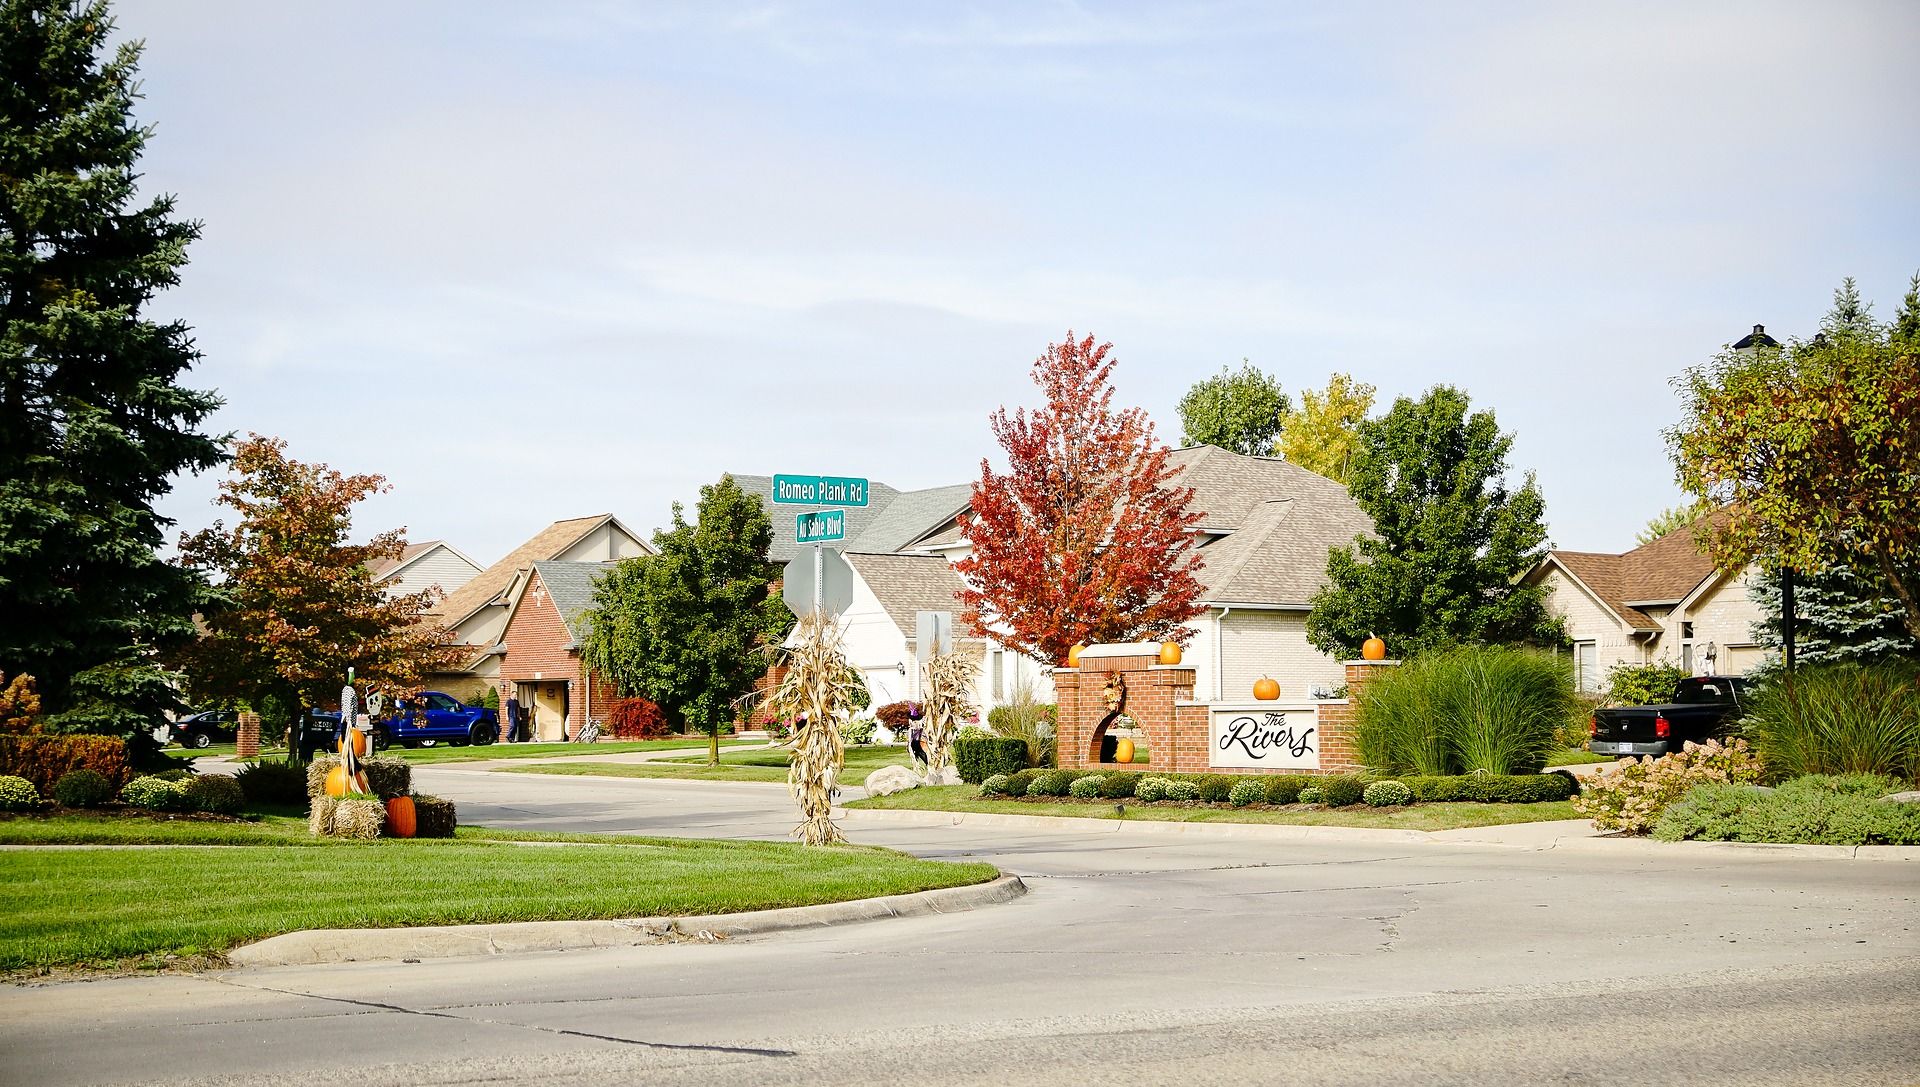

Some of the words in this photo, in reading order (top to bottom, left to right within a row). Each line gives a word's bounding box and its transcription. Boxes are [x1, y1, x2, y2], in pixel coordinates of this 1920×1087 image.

[779, 480, 814, 500] Romeo
[819, 481, 847, 502] Plank
[850, 483, 862, 502] Rd
[799, 519, 807, 538] Au
[808, 518, 825, 538] Sable
[826, 515, 841, 536] Blvd
[1261, 713, 1287, 726] The
[1220, 717, 1315, 759] Rivers
